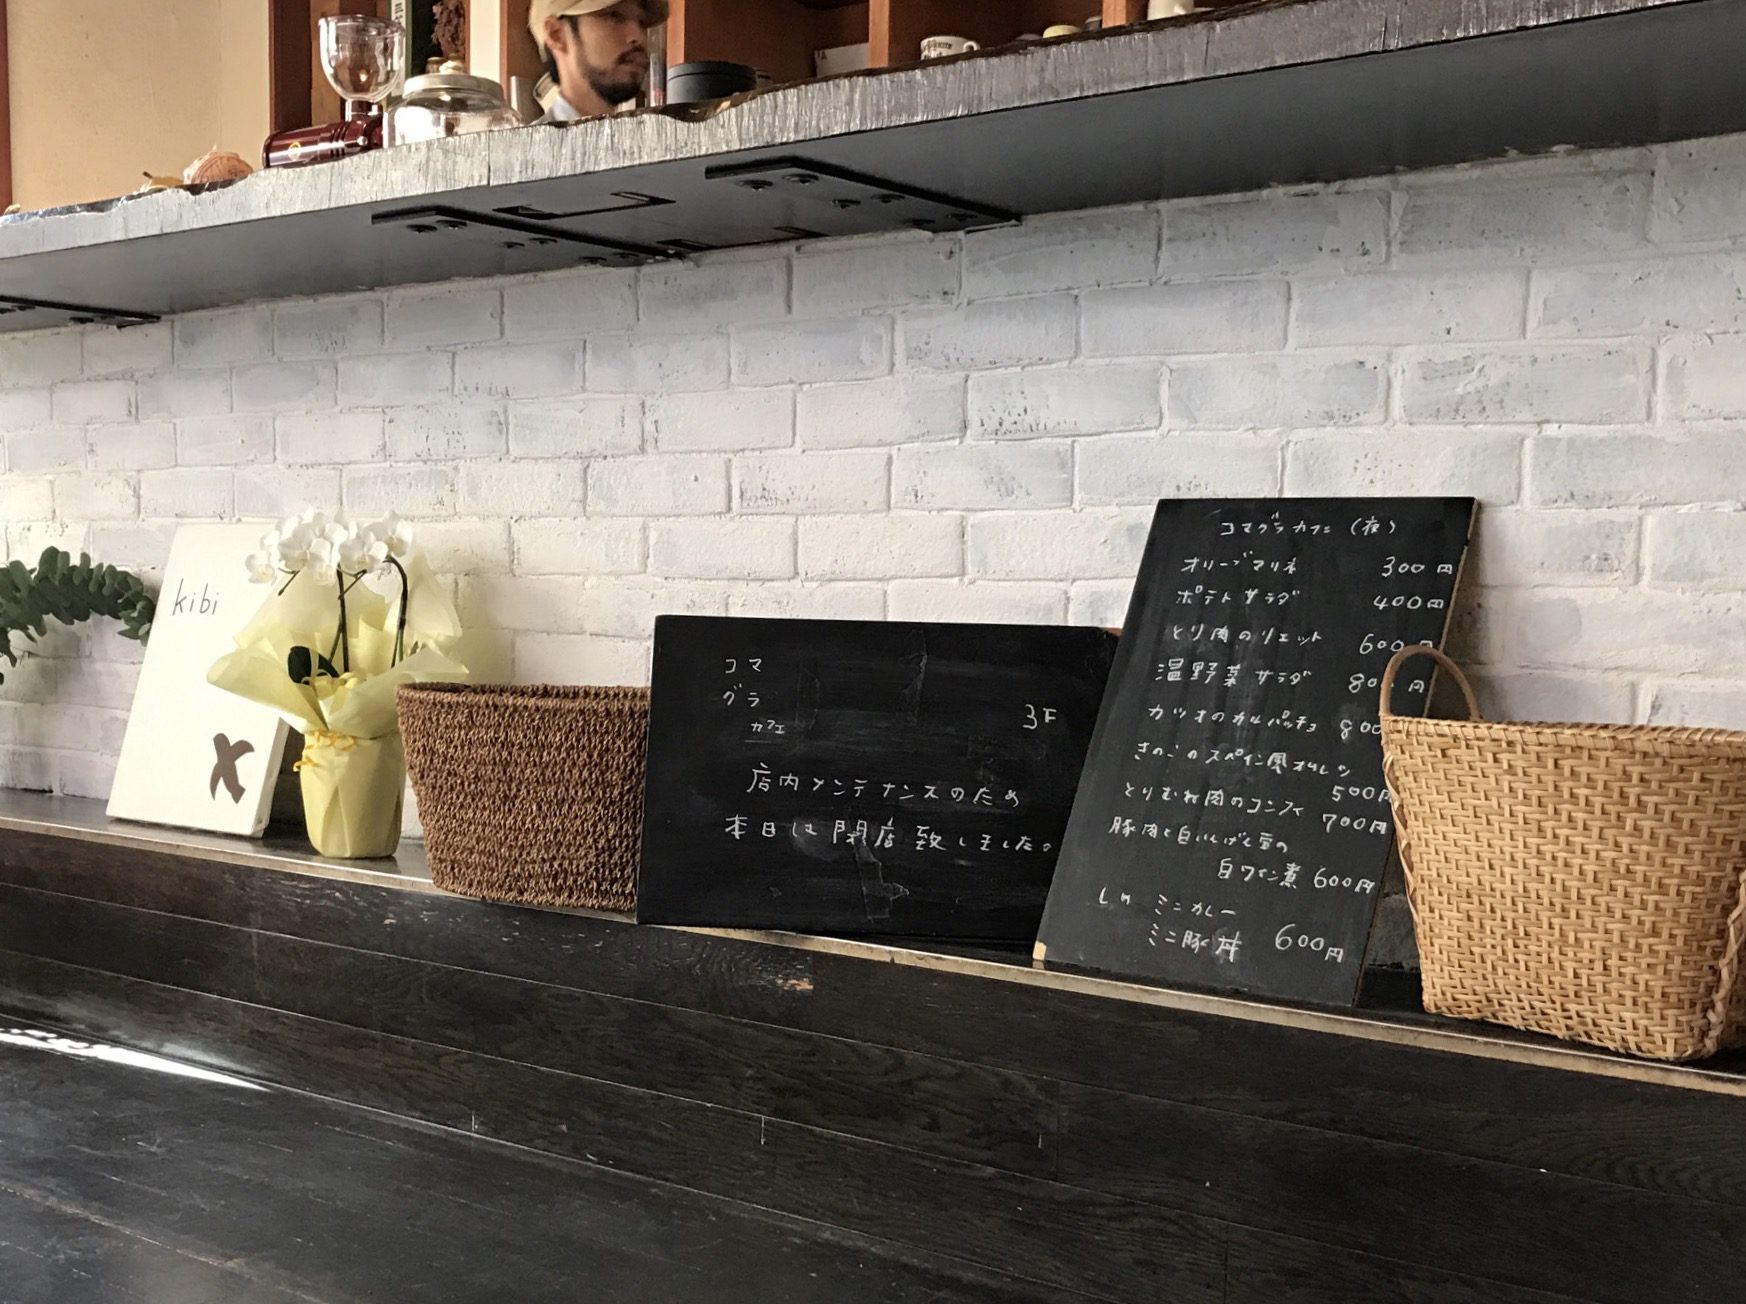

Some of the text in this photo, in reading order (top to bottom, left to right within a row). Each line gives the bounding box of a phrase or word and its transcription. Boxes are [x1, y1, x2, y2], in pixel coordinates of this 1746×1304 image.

[172, 578, 219, 616] kibi
[725, 658, 762, 674] コマ
[722, 682, 760, 708] グラ
[1022, 703, 1057, 730] 3F
[746, 761, 1020, 807] 店内メンテナンスのため
[1322, 813, 1387, 835] 700円
[1313, 868, 1376, 895] 600円
[1274, 923, 1344, 963] 600円
